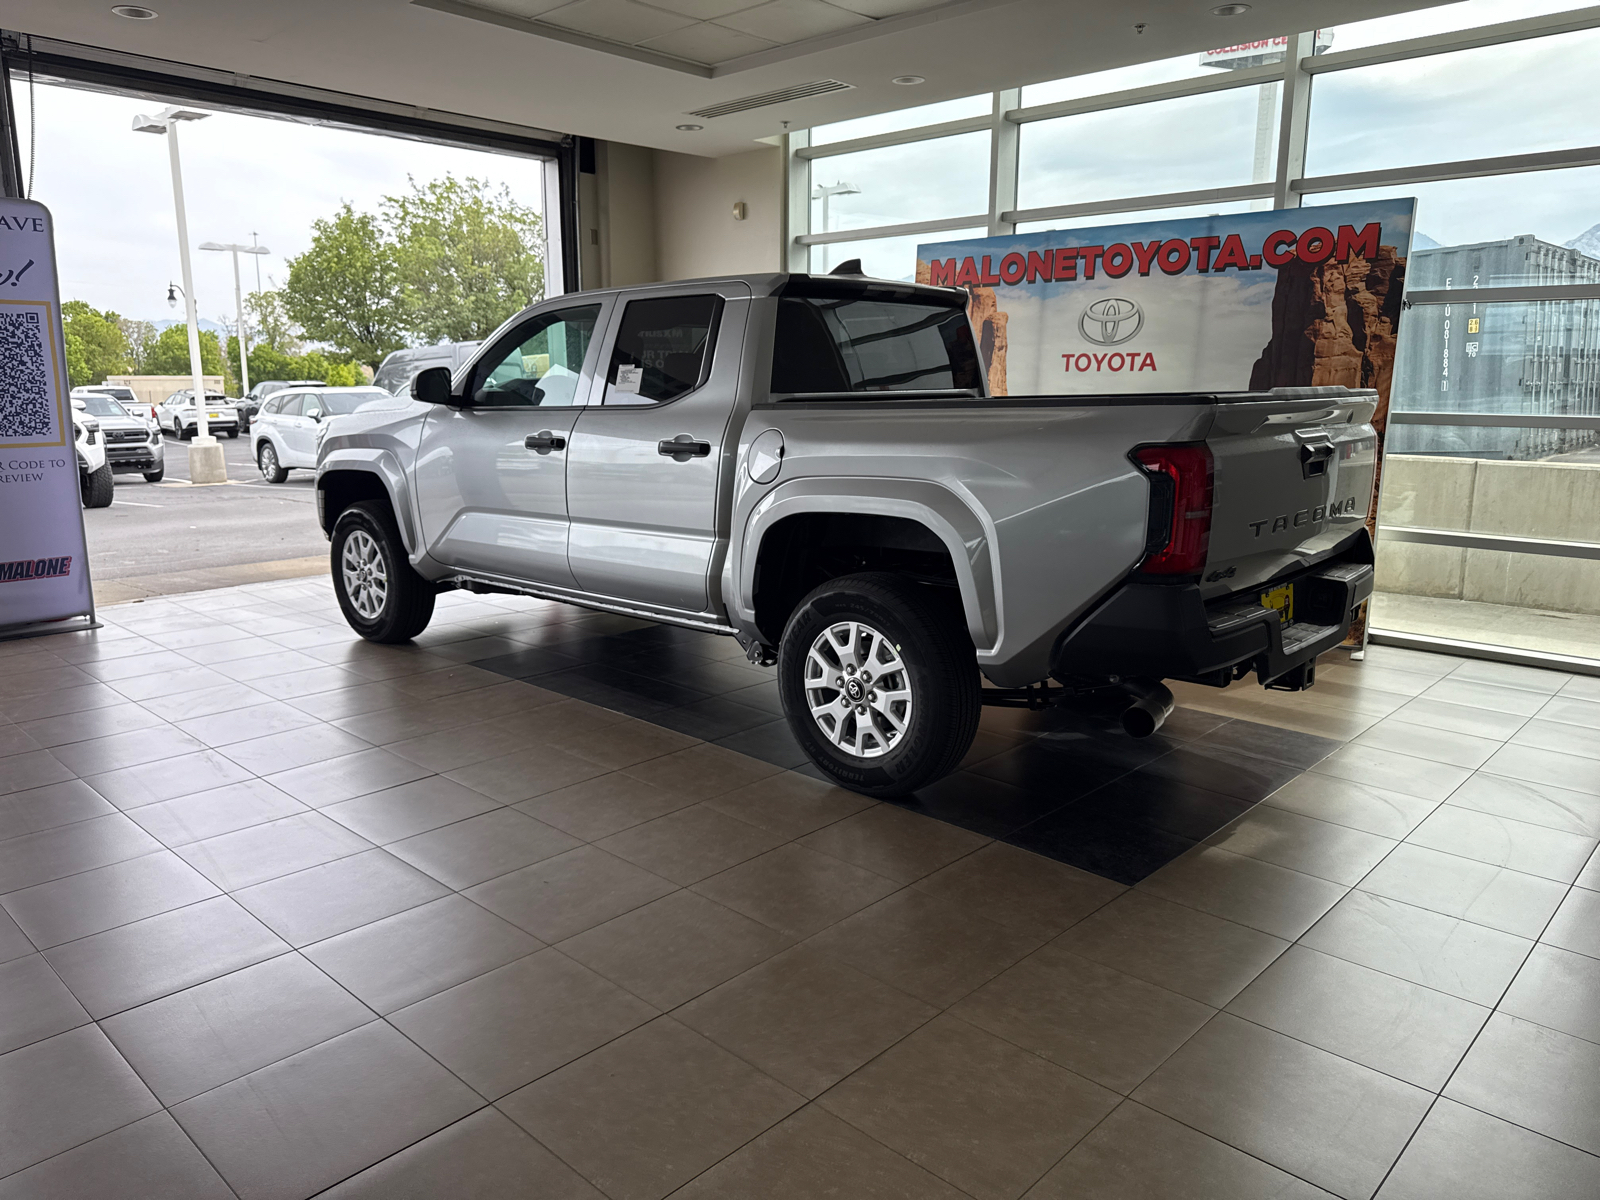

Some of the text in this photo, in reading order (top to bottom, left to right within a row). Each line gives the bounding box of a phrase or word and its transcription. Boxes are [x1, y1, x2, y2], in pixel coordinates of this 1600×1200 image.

[930, 222, 1381, 286] MALONETOYOTA.COM
[1062, 352, 1157, 372] TOYOTA
[8, 460, 46, 470] CODE
[48, 459, 66, 468] TO
[1249, 496, 1356, 538] TACOMA
